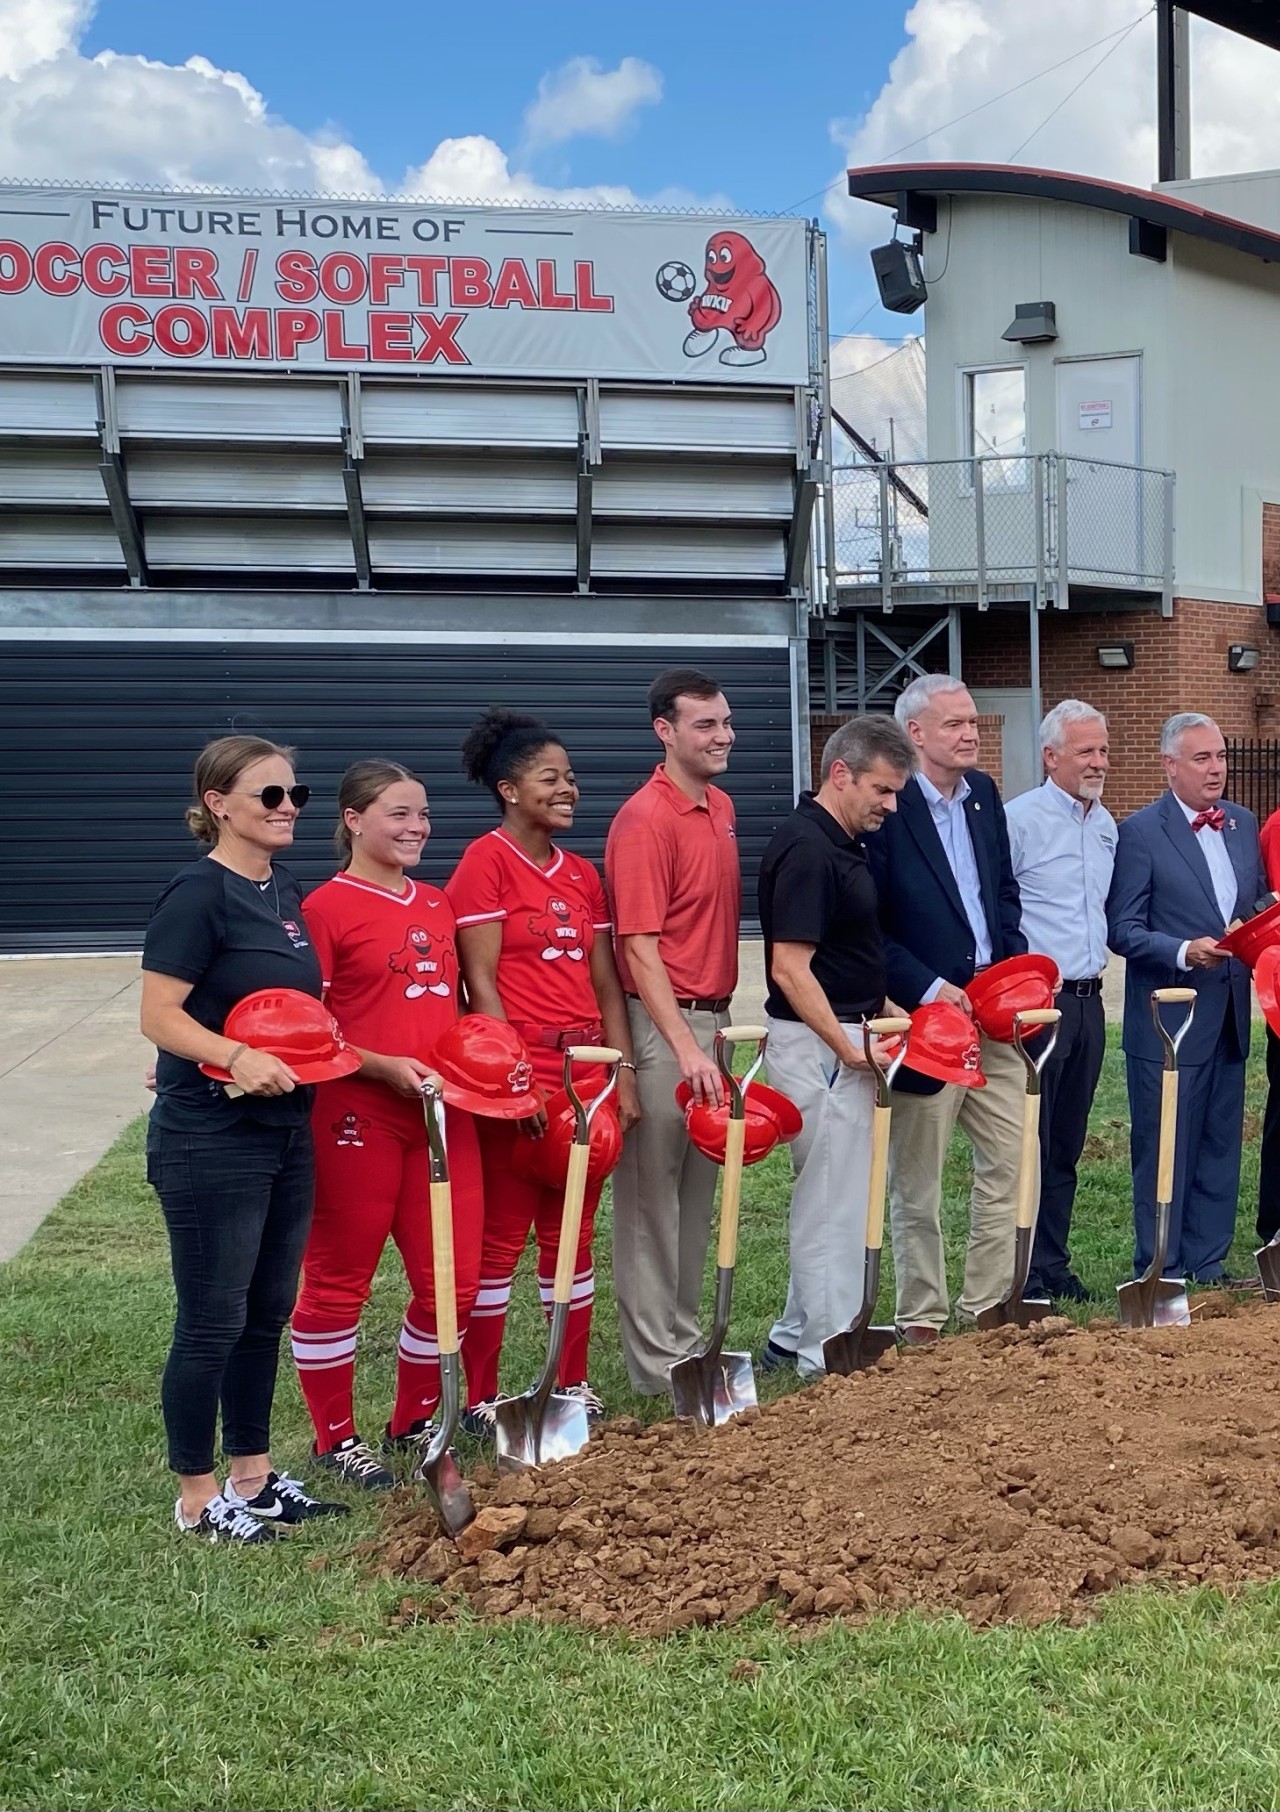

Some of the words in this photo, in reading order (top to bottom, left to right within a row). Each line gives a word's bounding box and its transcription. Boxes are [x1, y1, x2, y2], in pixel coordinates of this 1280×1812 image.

[92, 200, 262, 238] FUTURE
[276, 208, 401, 242] HOME
[412, 218, 465, 243] OF
[237, 248, 259, 302] /
[274, 250, 615, 313] SOFTBALL
[701, 294, 733, 314] WKU
[98, 302, 472, 366] COMPLEX
